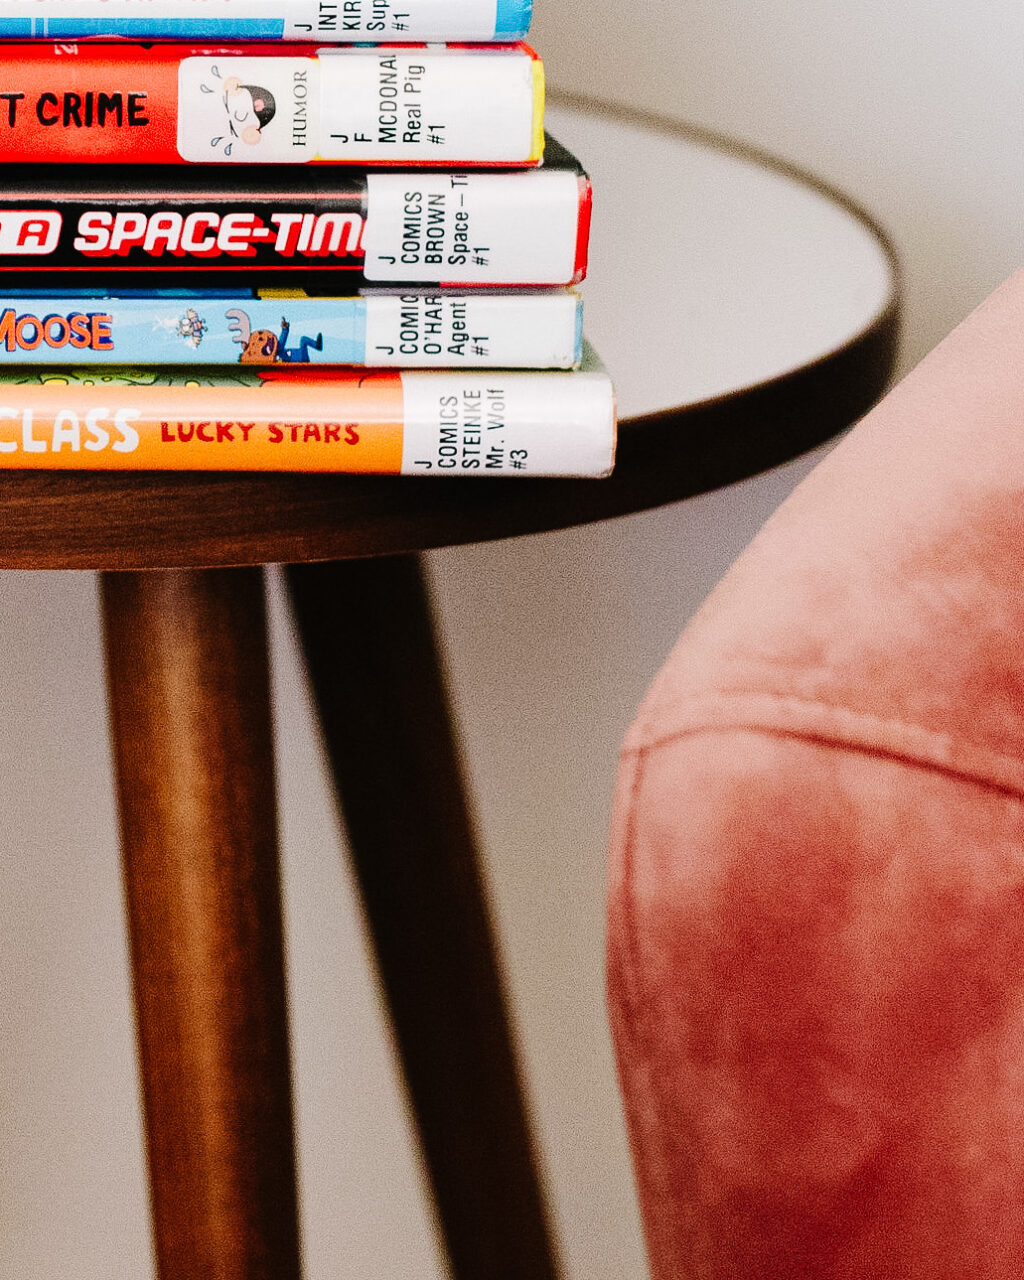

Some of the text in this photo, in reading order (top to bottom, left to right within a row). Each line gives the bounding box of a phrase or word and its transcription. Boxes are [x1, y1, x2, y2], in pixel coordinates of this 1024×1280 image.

[294, 24, 312, 32] J
[391, 13, 410, 32] #1
[36, 90, 150, 128] CRIME
[292, 70, 307, 147] HUMOR
[402, 64, 426, 143] Real Pig
[330, 133, 349, 143] J
[354, 132, 372, 143] F
[426, 124, 446, 144] #1
[16, 219, 51, 247] A
[73, 210, 367, 256] SPACE-TIM
[400, 191, 422, 264] COMICS
[424, 193, 445, 264] BROWN
[377, 255, 396, 265] J
[472, 246, 490, 266] #1
[447, 302, 469, 356] Agent
[375, 346, 394, 356] J
[470, 336, 489, 357] #1
[161, 421, 256, 443] LUCKY
[269, 422, 360, 446] STARS
[438, 396, 458, 468] COMICS
[461, 390, 481, 469] STEINKE
[485, 388, 505, 469] Mr. Wolf
[414, 460, 433, 469] J
[508, 449, 528, 470] #3
